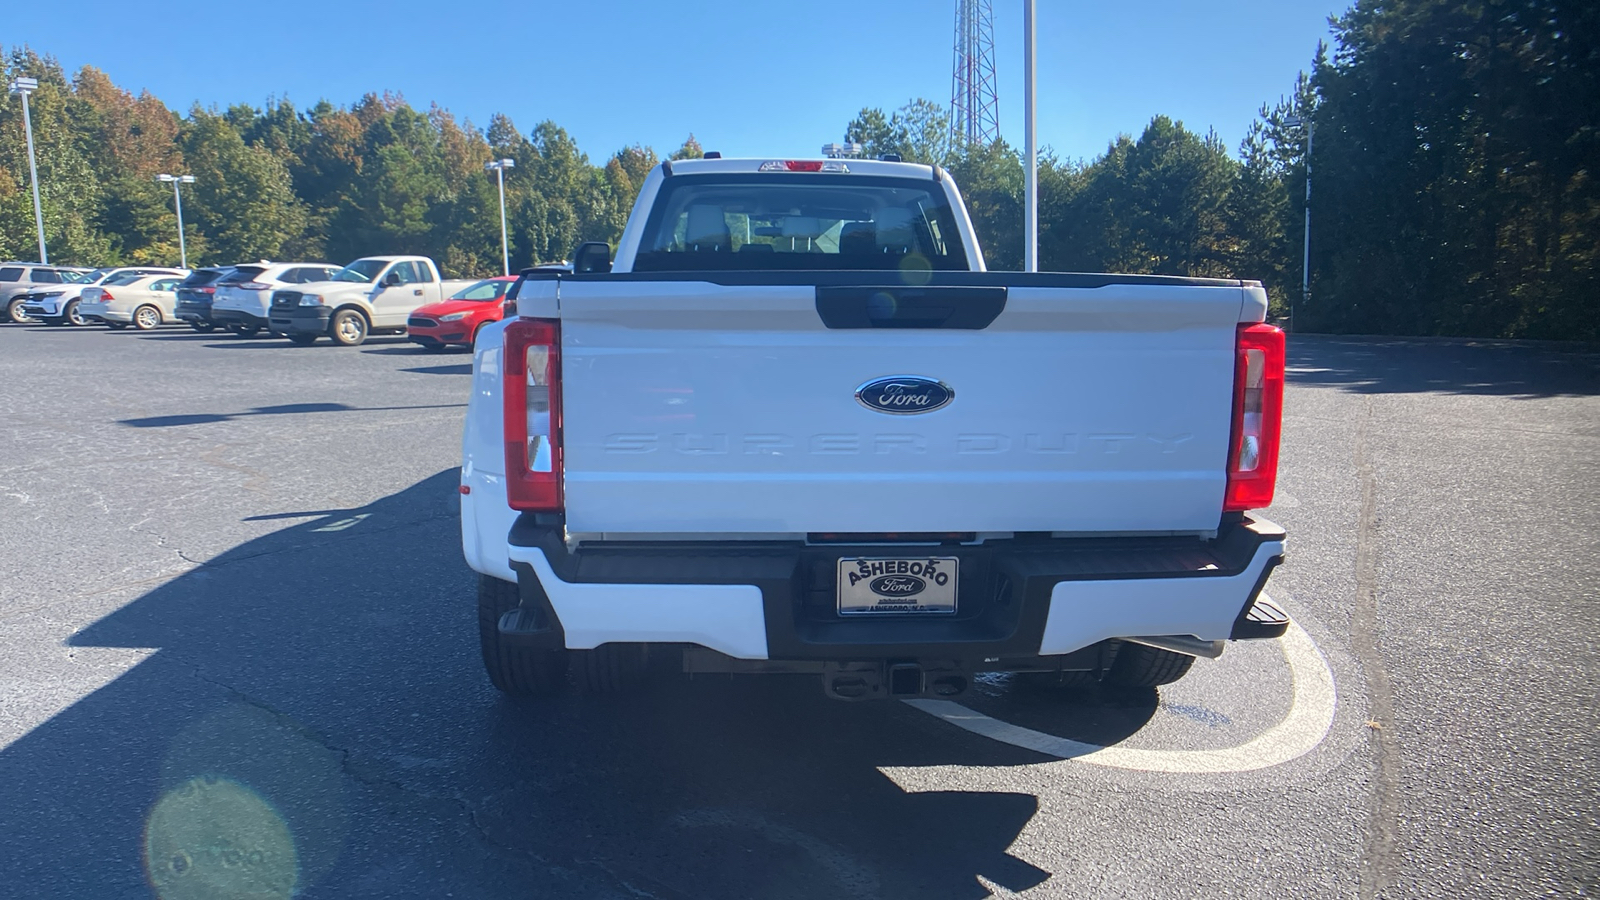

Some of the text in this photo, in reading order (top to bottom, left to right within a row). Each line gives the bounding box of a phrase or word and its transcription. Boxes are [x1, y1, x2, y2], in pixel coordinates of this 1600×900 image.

[878, 383, 932, 406] Ford
[602, 431, 1195, 456] SUPER DUTY
[848, 561, 949, 587] ASHEBORO
[880, 578, 914, 592] Ford
